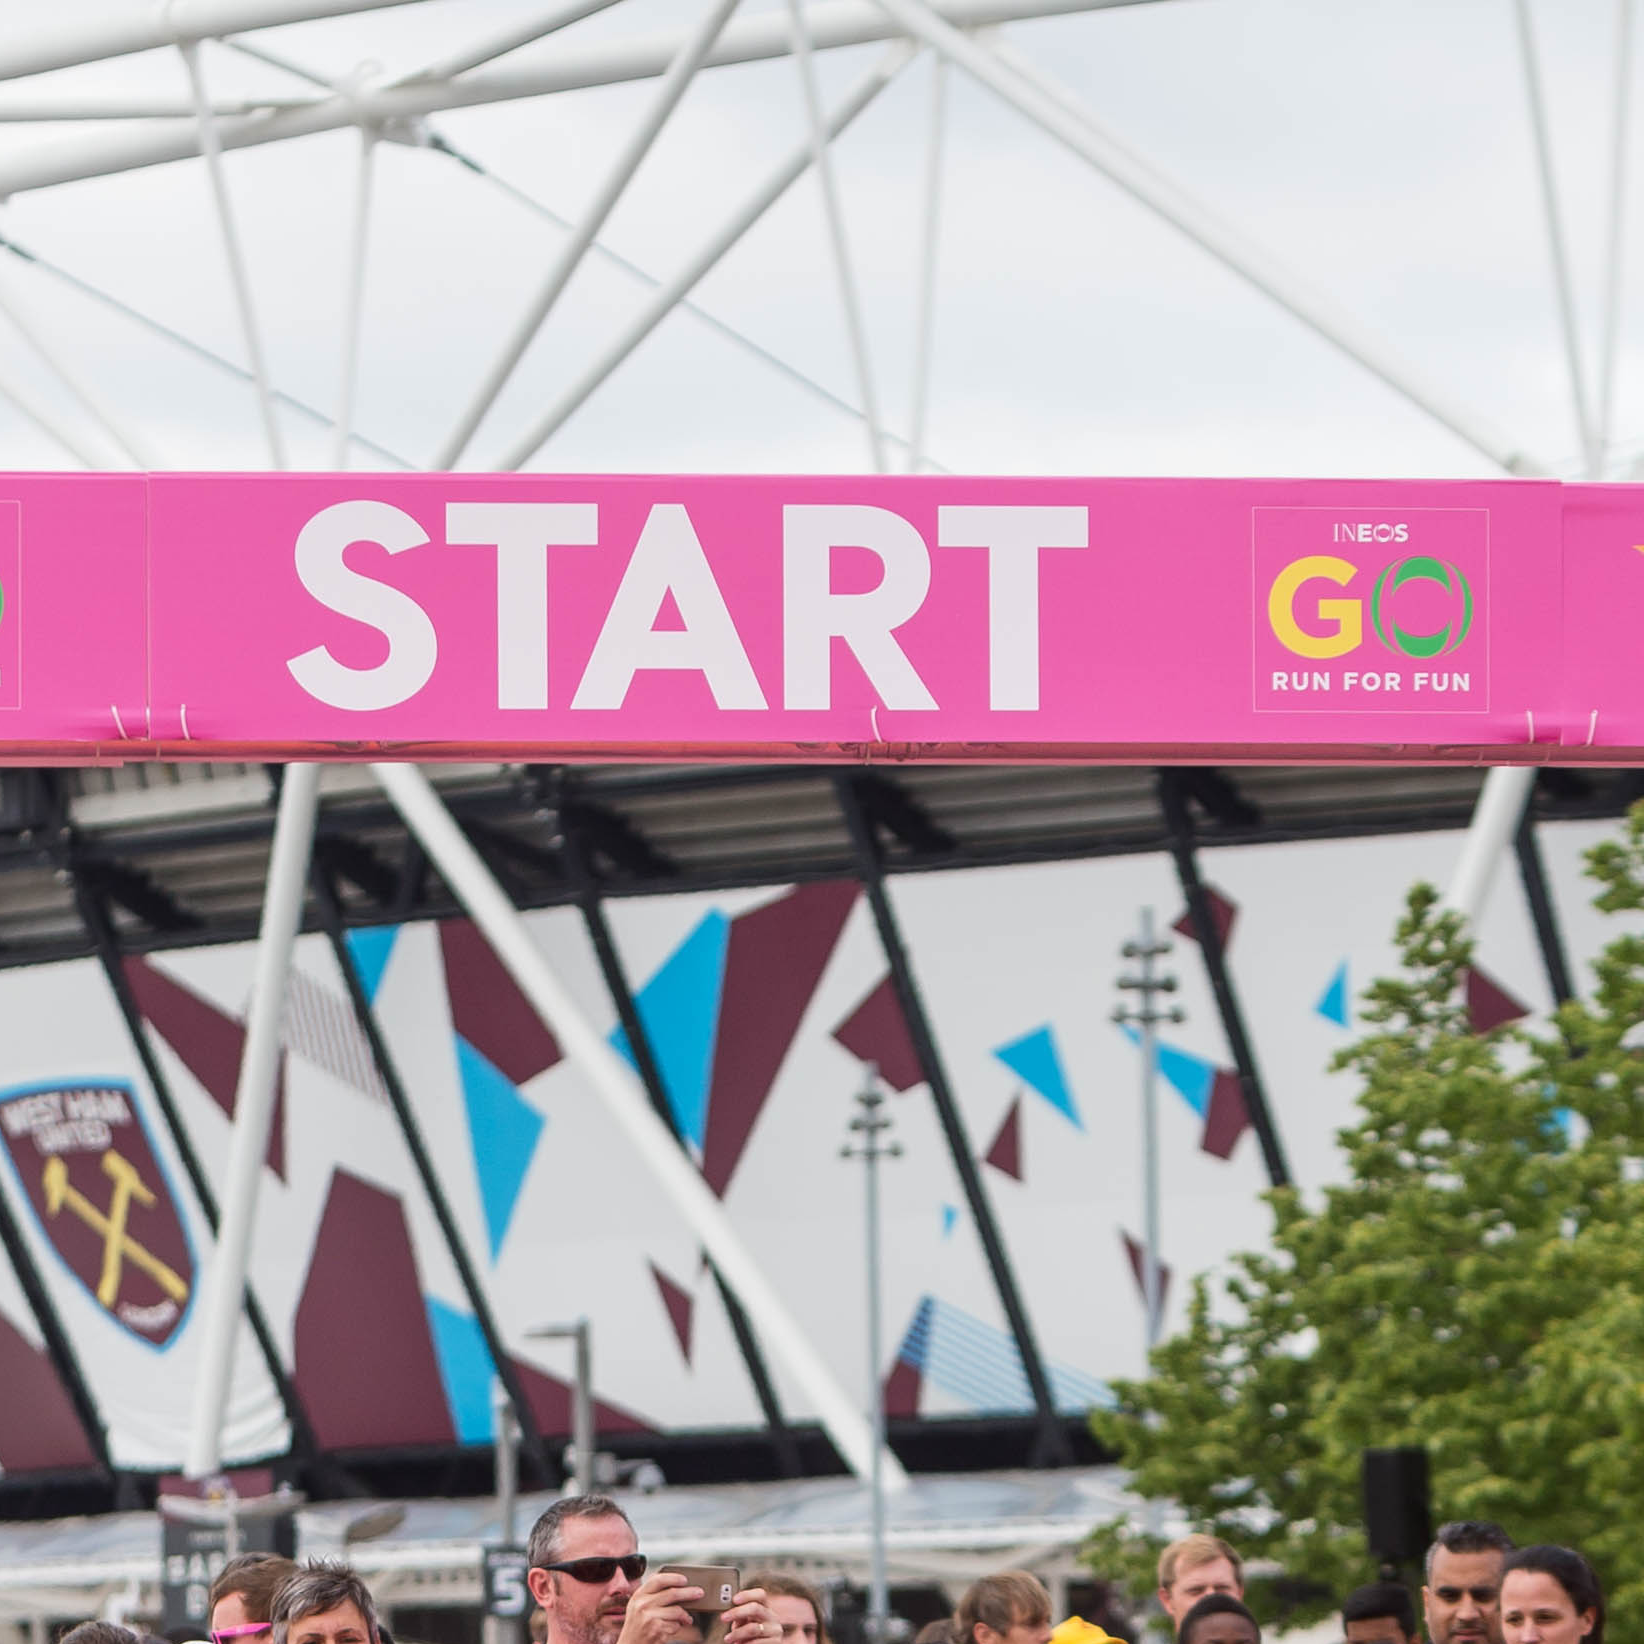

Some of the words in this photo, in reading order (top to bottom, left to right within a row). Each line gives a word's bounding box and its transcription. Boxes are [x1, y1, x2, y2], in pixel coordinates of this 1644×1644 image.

[1333, 523, 1408, 543] INEOS
[285, 499, 1090, 713] START
[1266, 554, 1475, 660] GO
[1271, 671, 1331, 693] RUN
[1344, 671, 1404, 693] FOR
[1414, 672, 1471, 694] FUN
